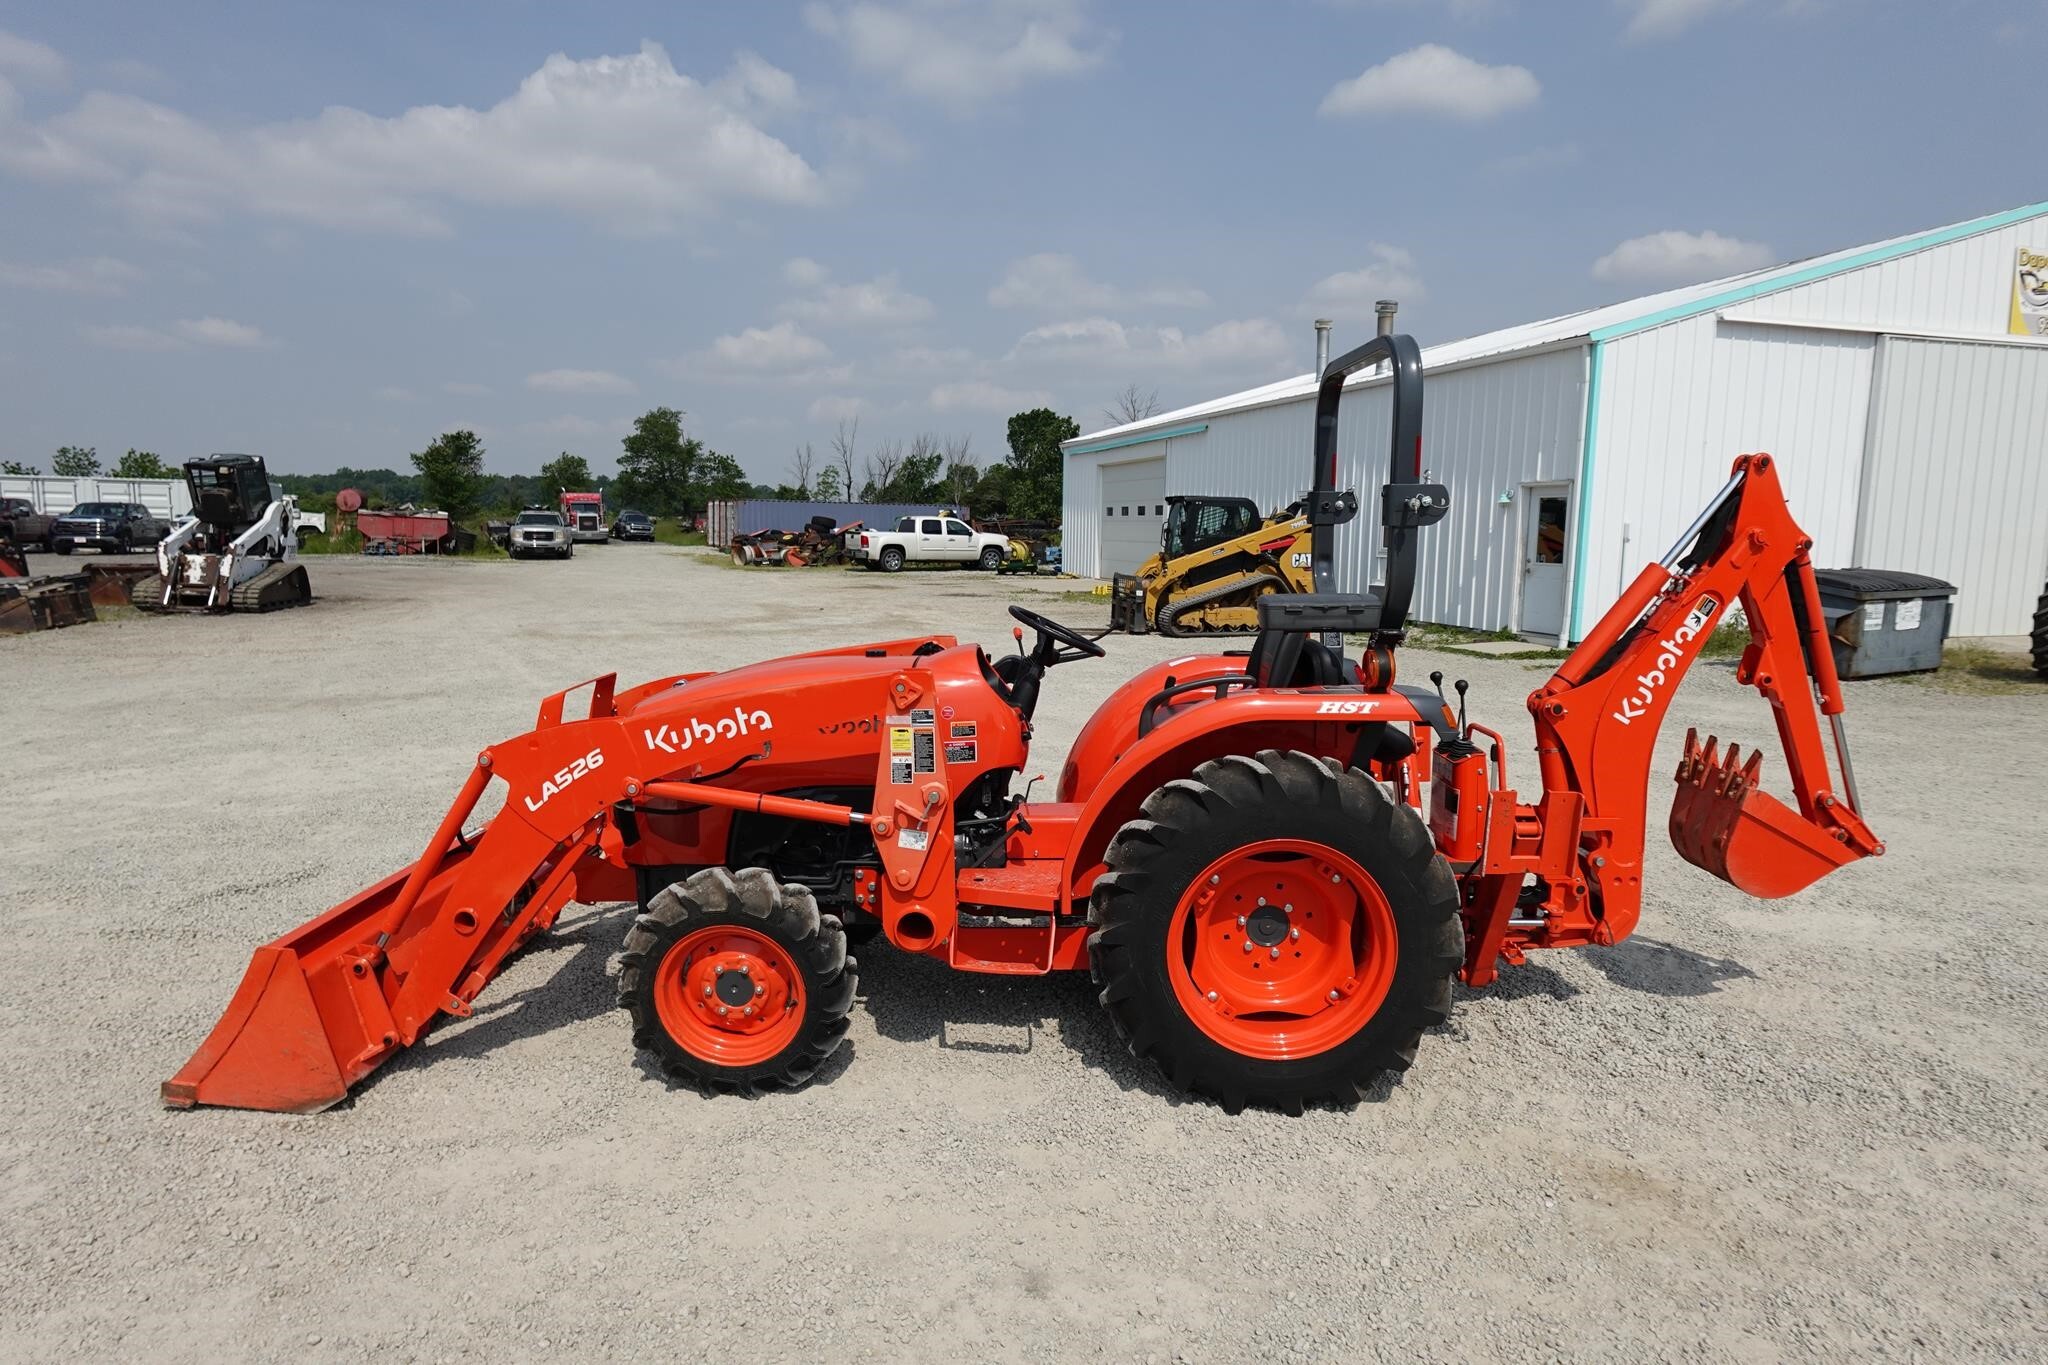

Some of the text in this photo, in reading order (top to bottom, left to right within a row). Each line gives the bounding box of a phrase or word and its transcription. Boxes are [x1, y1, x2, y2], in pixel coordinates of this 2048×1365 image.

[1613, 626, 1697, 725] Kubota
[644, 706, 773, 753] Kubota
[1316, 701, 1380, 714] HST
[524, 748, 604, 812] LA526
